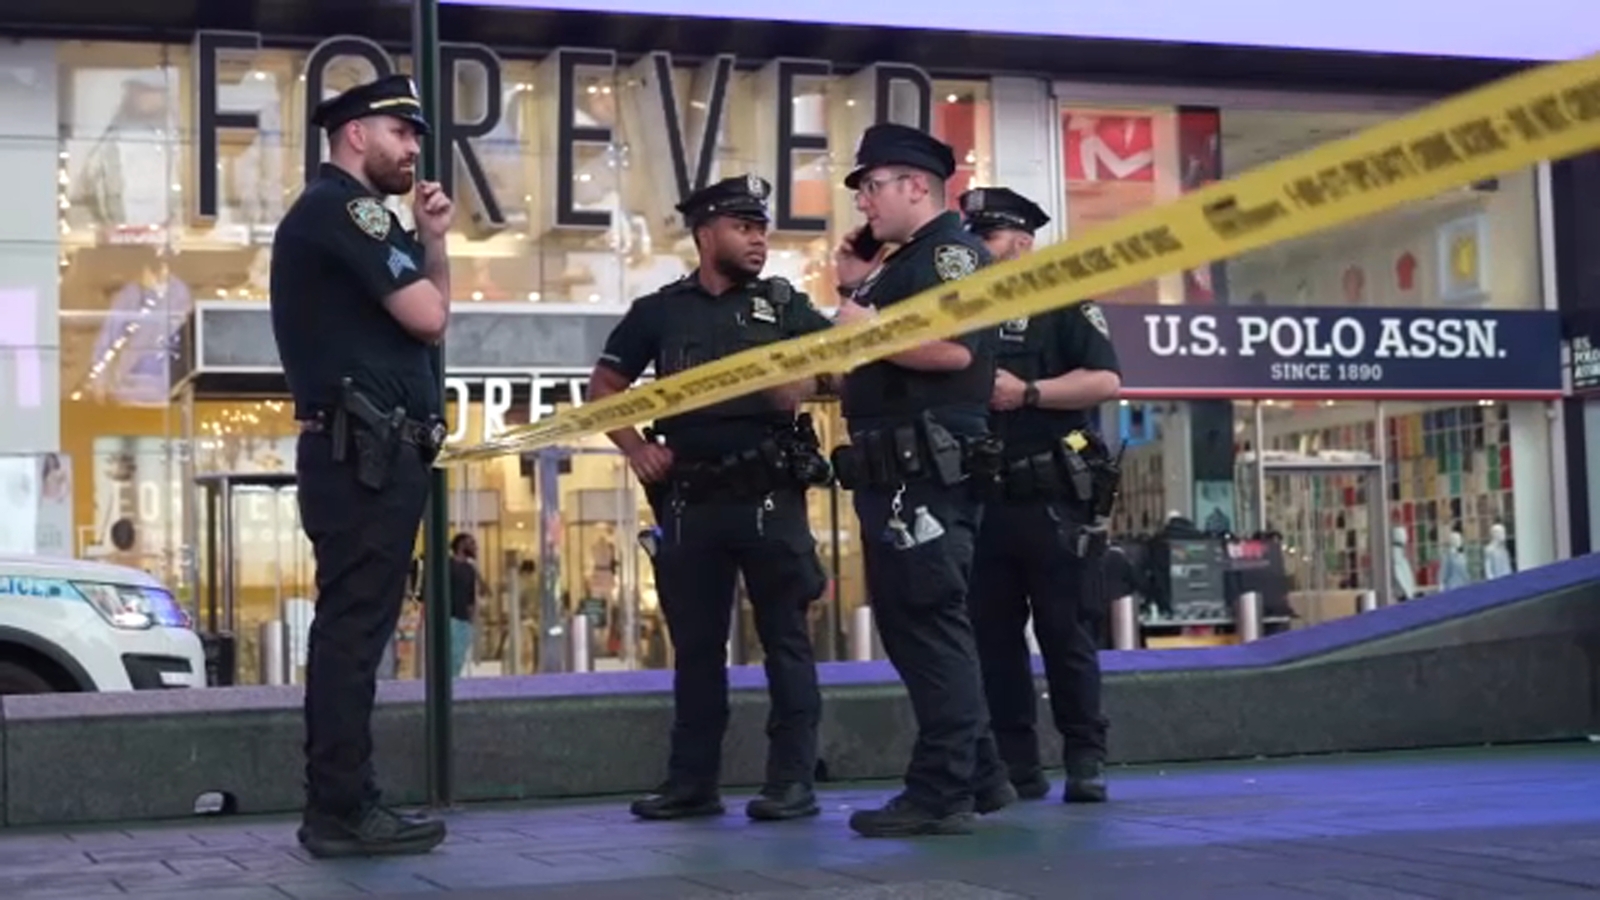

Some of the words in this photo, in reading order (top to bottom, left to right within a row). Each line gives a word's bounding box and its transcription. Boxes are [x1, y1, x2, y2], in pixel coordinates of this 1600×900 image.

[1145, 315, 1226, 356] U.S.
[1238, 317, 1366, 358] POLO
[1375, 319, 1507, 359] ASSN.
[1271, 363, 1331, 381] SINCE
[1338, 364, 1383, 381] 1890
